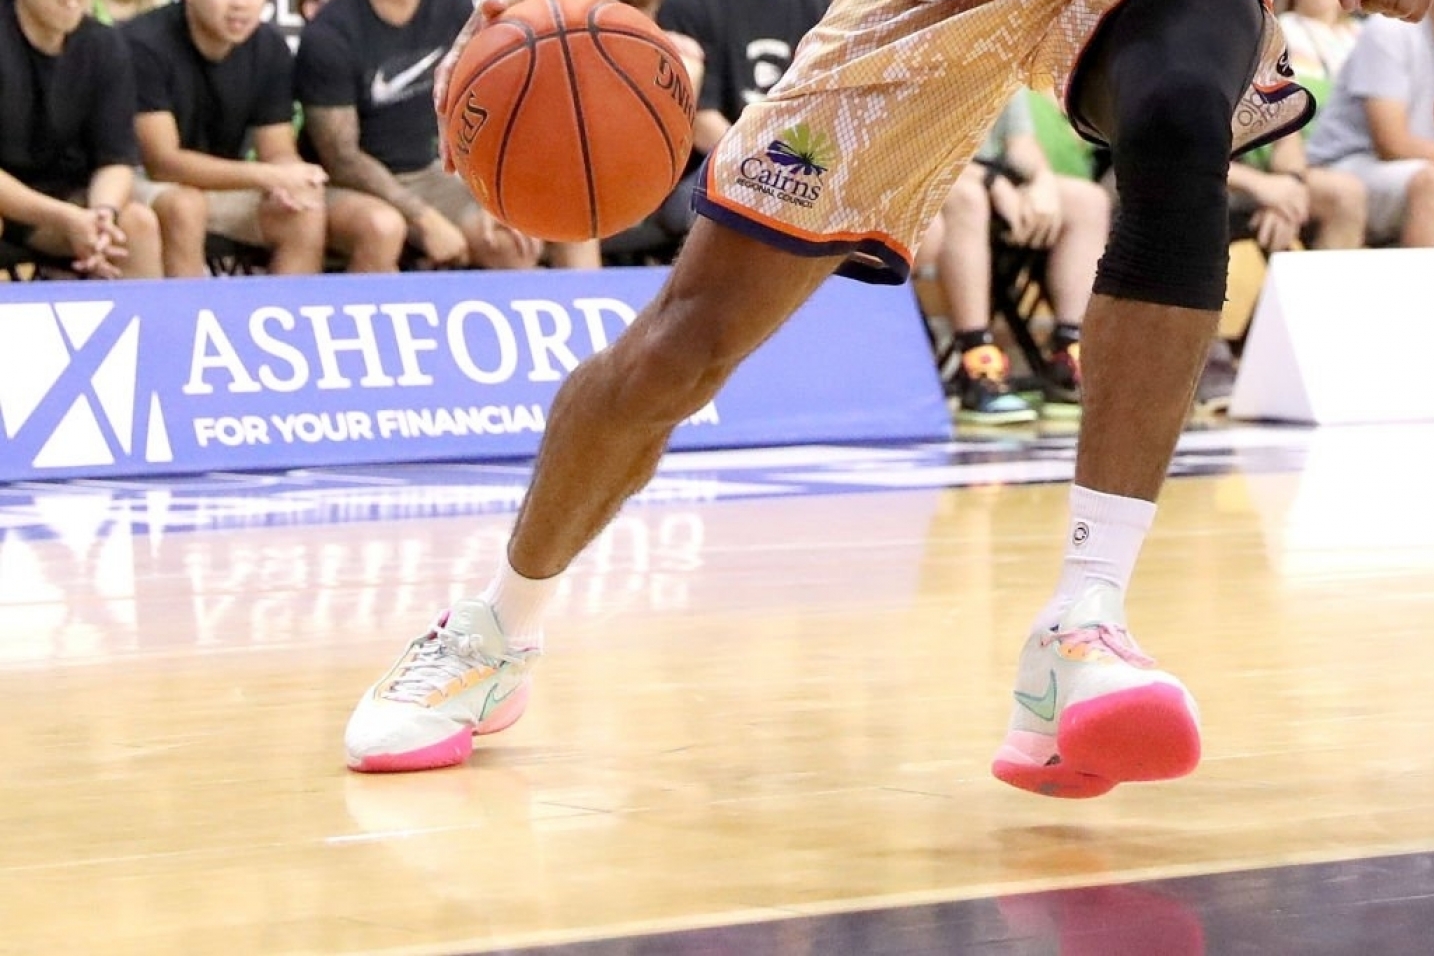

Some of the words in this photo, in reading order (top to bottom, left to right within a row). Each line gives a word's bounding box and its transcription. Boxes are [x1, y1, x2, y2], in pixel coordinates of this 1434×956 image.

[741, 157, 822, 201] Cairns
[181, 297, 638, 395] ASHFORD
[192, 414, 271, 448] FOR
[269, 410, 375, 445] YOUR
